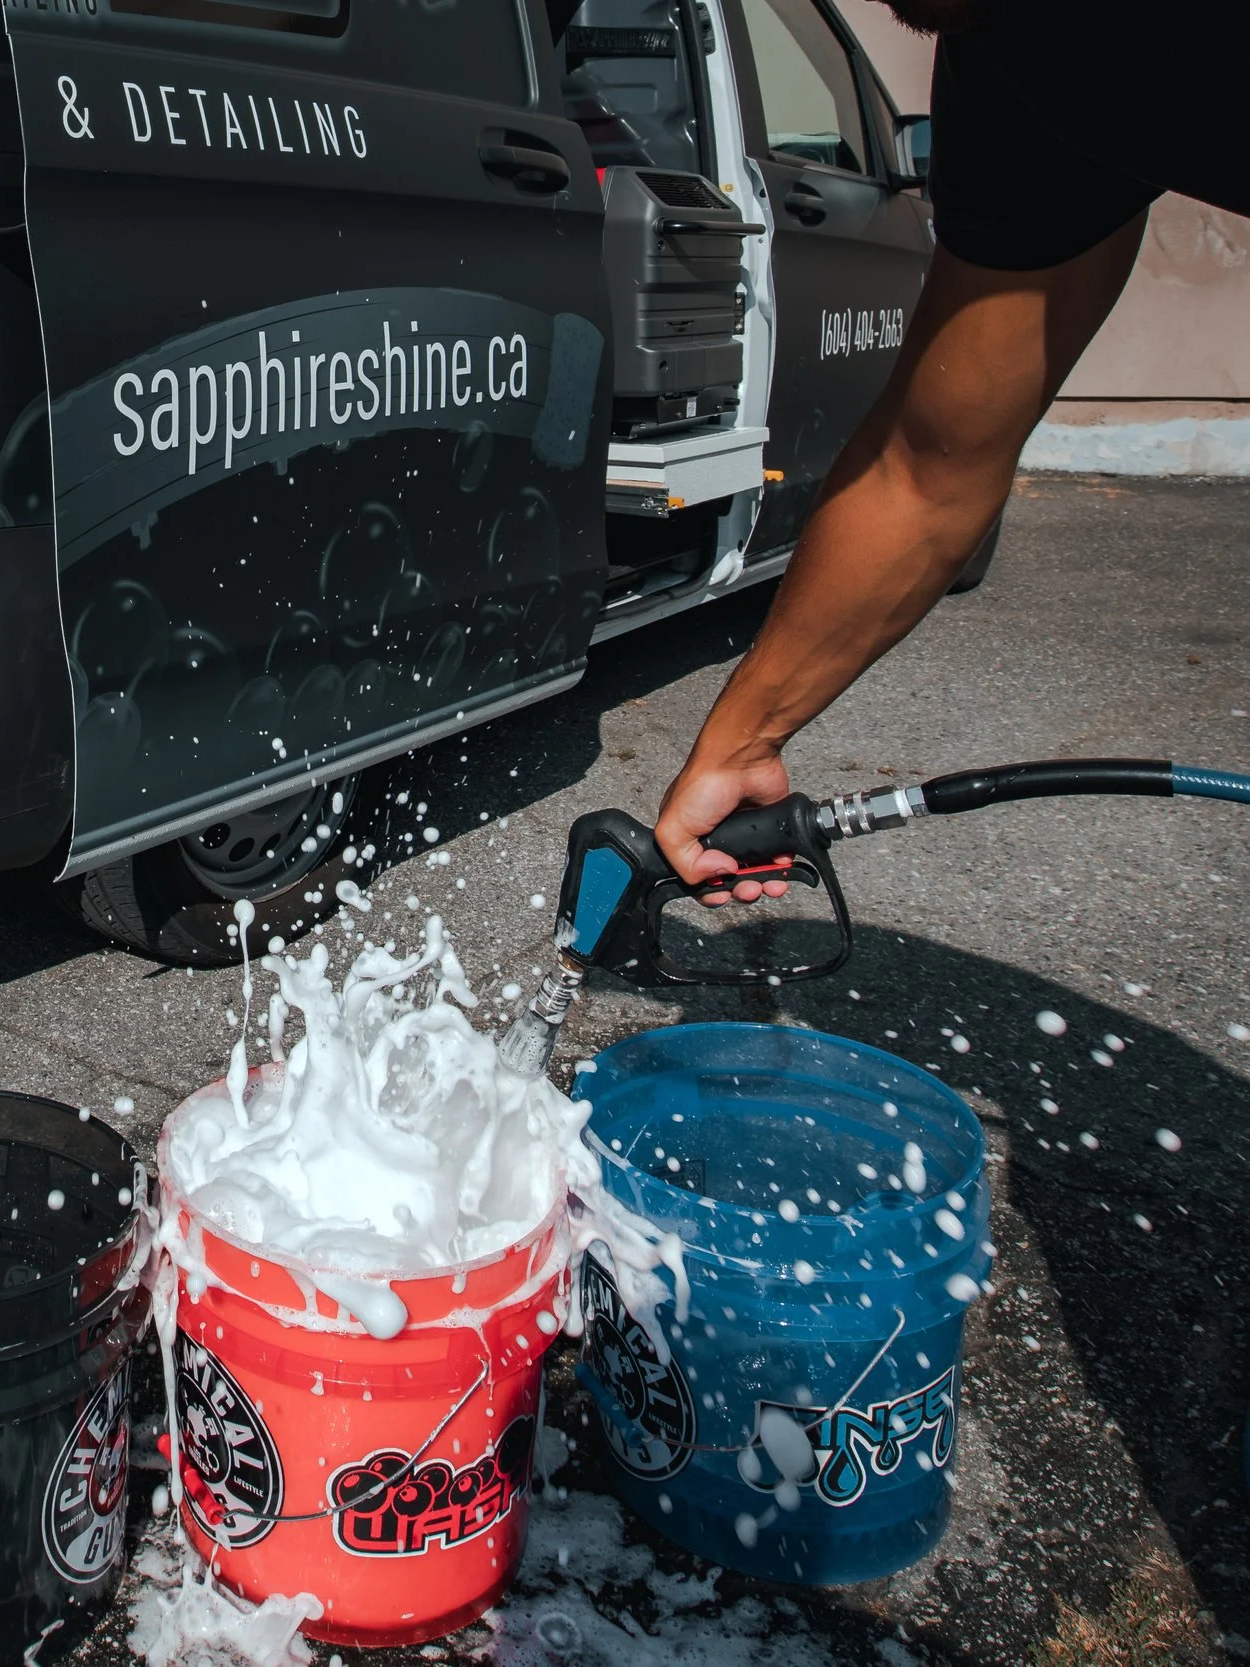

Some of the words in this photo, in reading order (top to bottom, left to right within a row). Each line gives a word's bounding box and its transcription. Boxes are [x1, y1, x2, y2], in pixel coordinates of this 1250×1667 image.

[57, 75, 95, 139] &
[122, 81, 368, 158] DETAILING
[820, 308, 851, 361] (604)
[854, 308, 904, 351] 404-2663
[112, 320, 528, 475] sapphireshine.ca
[754, 1370, 954, 1462] INSE
[233, 1474, 265, 1498] LIFESTYLE
[59, 1509, 88, 1534] TRADITION
